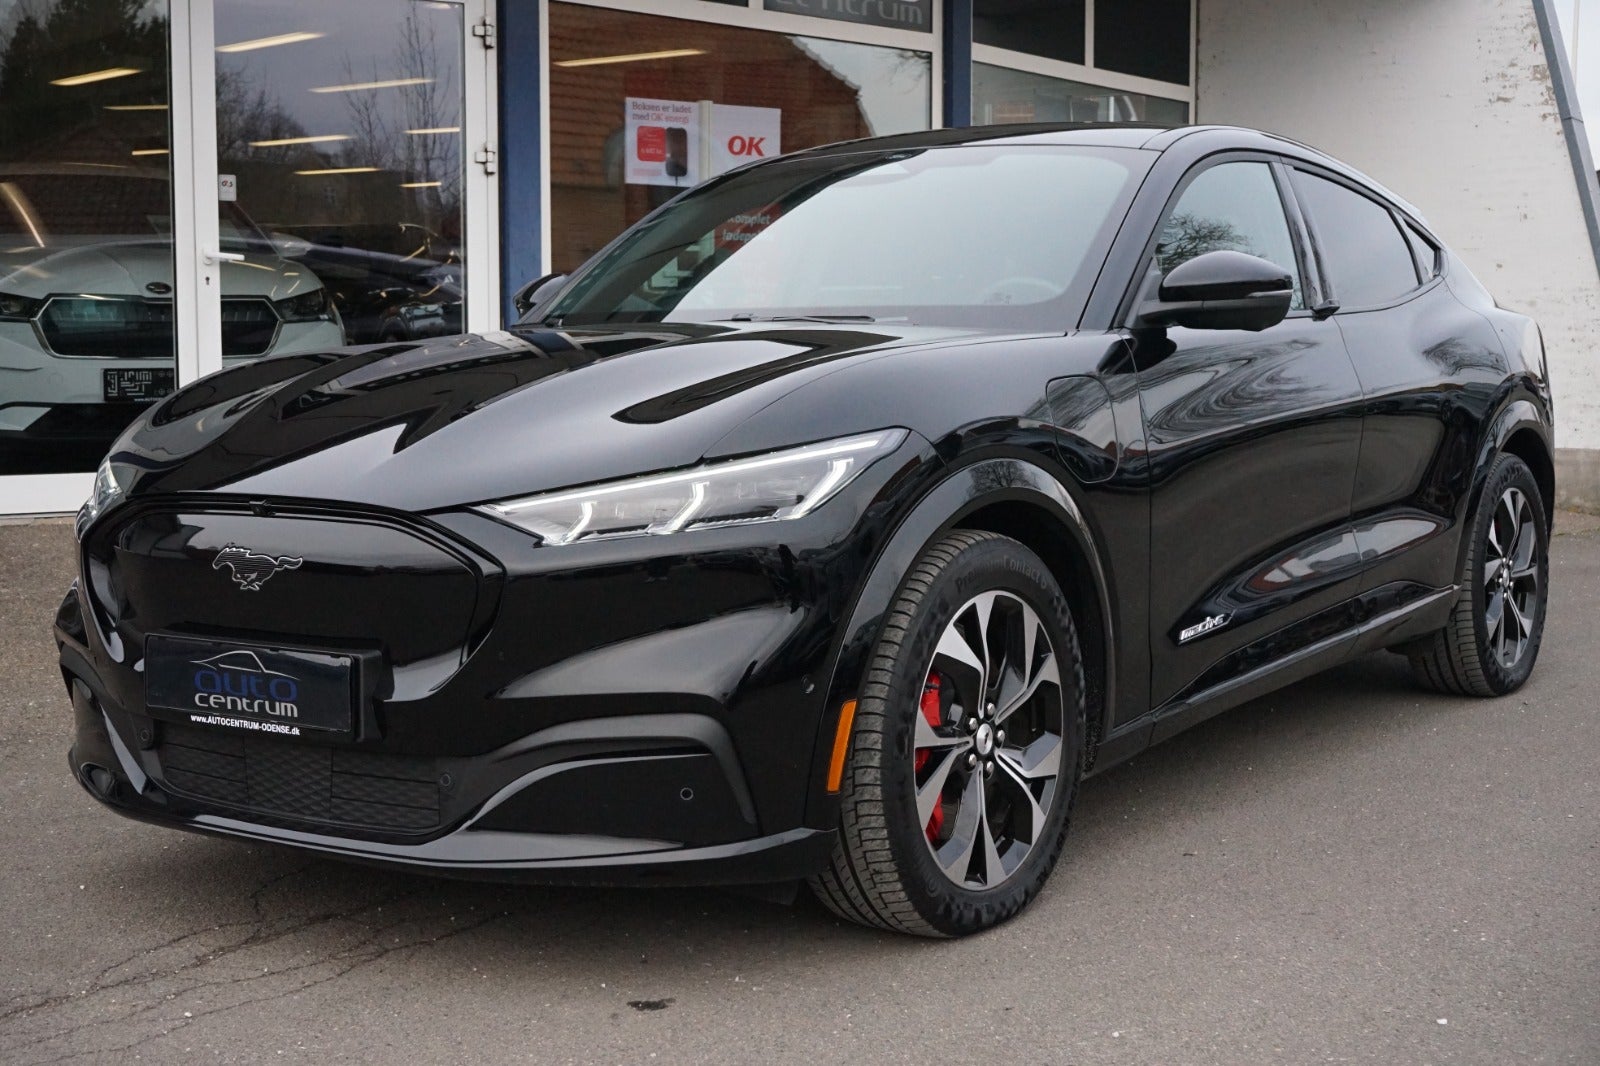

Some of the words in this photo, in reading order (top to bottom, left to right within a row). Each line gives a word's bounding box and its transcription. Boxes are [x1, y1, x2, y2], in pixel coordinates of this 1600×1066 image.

[728, 135, 765, 157] OK
[194, 669, 298, 702] auto
[194, 693, 298, 718] centrum
[190, 715, 300, 736] www.AUTOCENTRUM-ODENSE.dk
